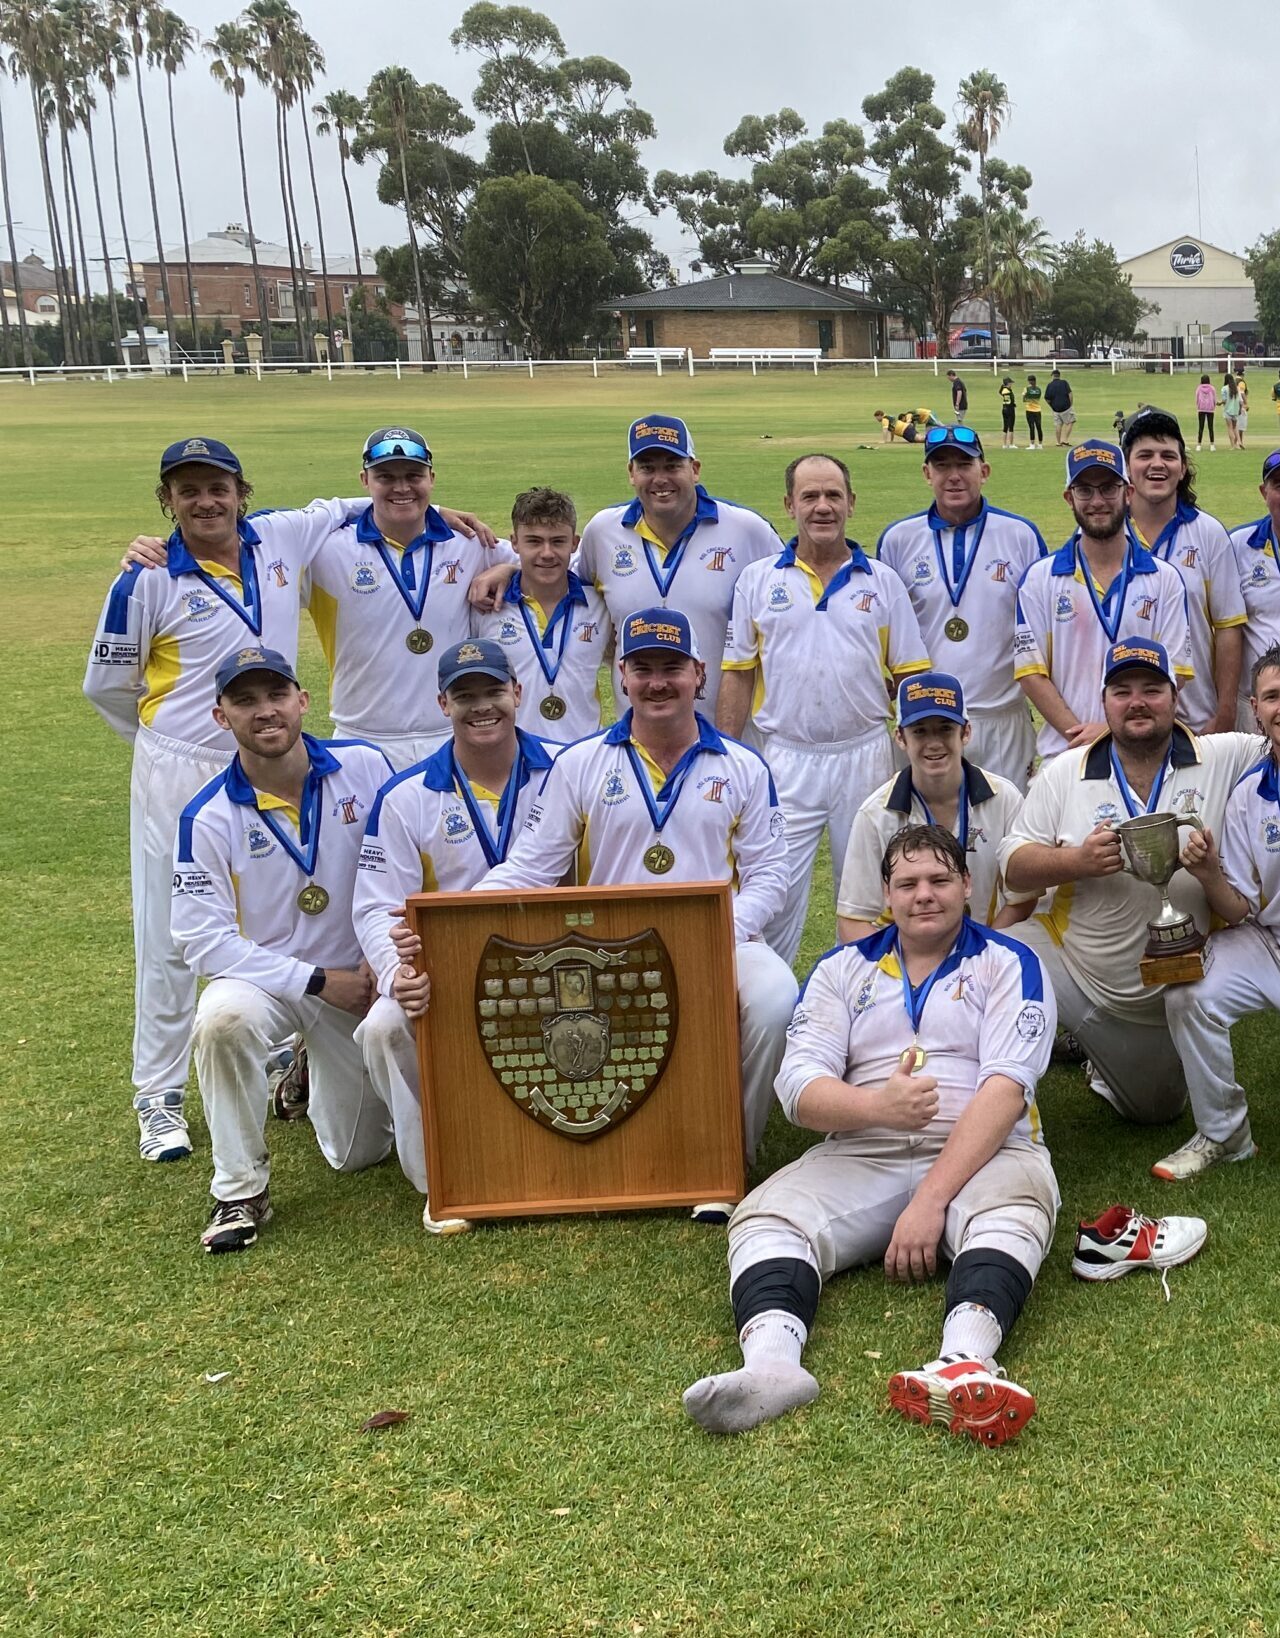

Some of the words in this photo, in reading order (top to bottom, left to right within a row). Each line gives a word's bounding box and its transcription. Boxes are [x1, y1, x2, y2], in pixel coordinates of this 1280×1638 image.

[1172, 252, 1201, 266] Thrive
[658, 435, 679, 444] CLUB
[1097, 455, 1115, 465] CLUB
[631, 618, 644, 627] RSL
[631, 623, 681, 637] CRICKET
[656, 633, 680, 643] CLUB
[907, 688, 955, 701] CRICKET
[935, 698, 956, 707] CLUB
[441, 806, 460, 815] CLUB
[1022, 1012, 1043, 1021] NKT
